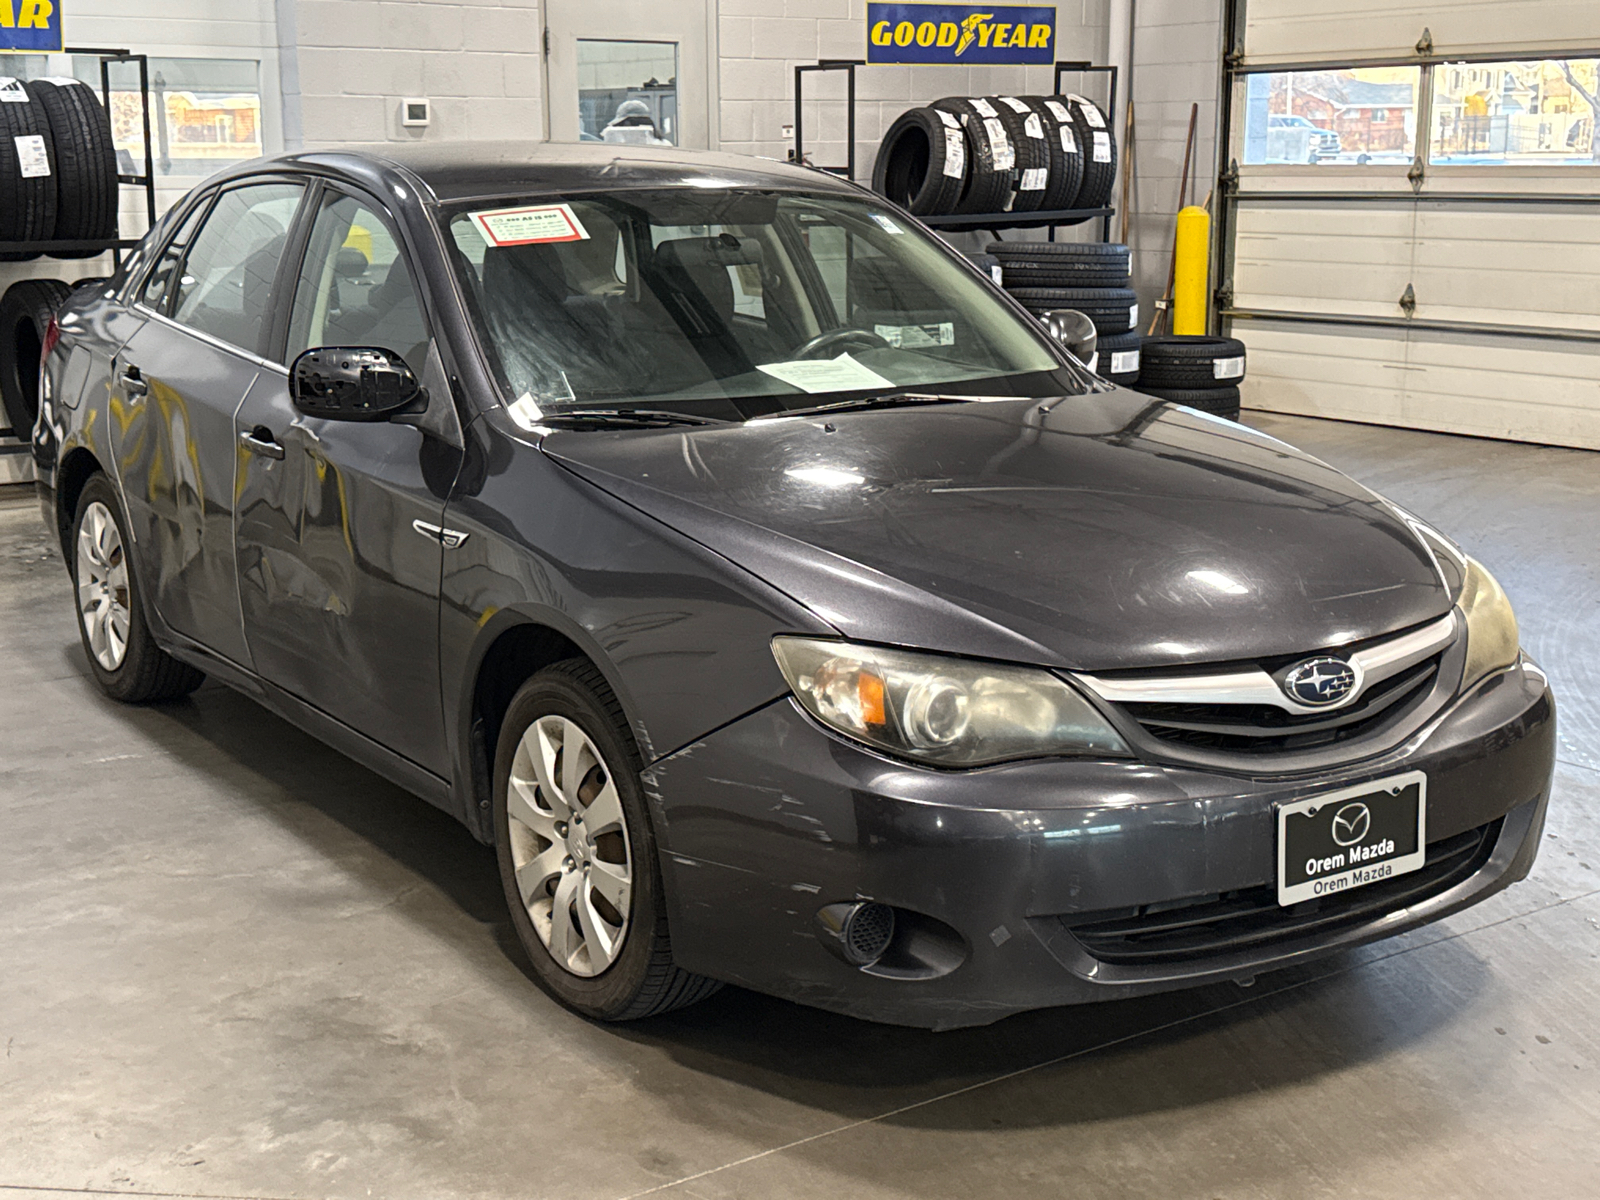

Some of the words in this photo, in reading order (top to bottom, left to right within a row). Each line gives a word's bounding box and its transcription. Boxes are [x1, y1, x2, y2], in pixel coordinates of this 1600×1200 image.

[1305, 854, 1345, 875] Orem
[1349, 838, 1395, 864] Mazda
[1313, 875, 1348, 895] Orem
[1352, 864, 1393, 885] Mazda
